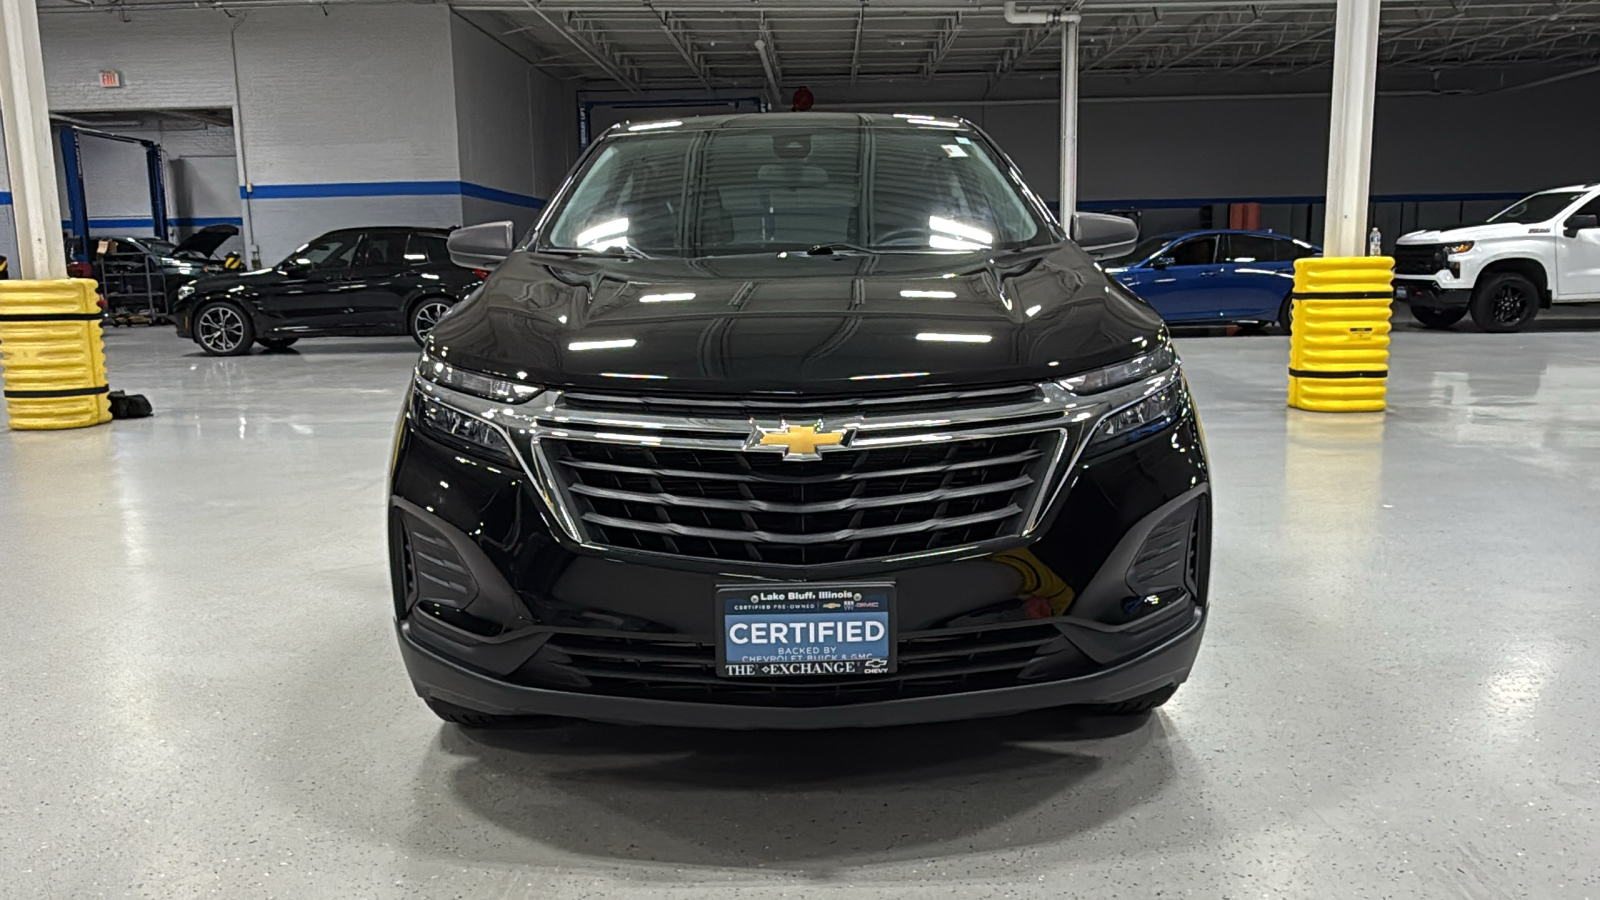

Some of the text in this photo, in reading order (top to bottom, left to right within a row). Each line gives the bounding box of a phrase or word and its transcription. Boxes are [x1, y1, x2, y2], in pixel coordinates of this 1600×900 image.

[760, 592, 785, 601] Lake
[818, 590, 853, 599] Illinois
[729, 620, 885, 644] CERTIFIED
[778, 646, 837, 655] BACKED BY
[725, 661, 856, 676] THE EXCHANGE
[863, 667, 889, 675] CHEVY
